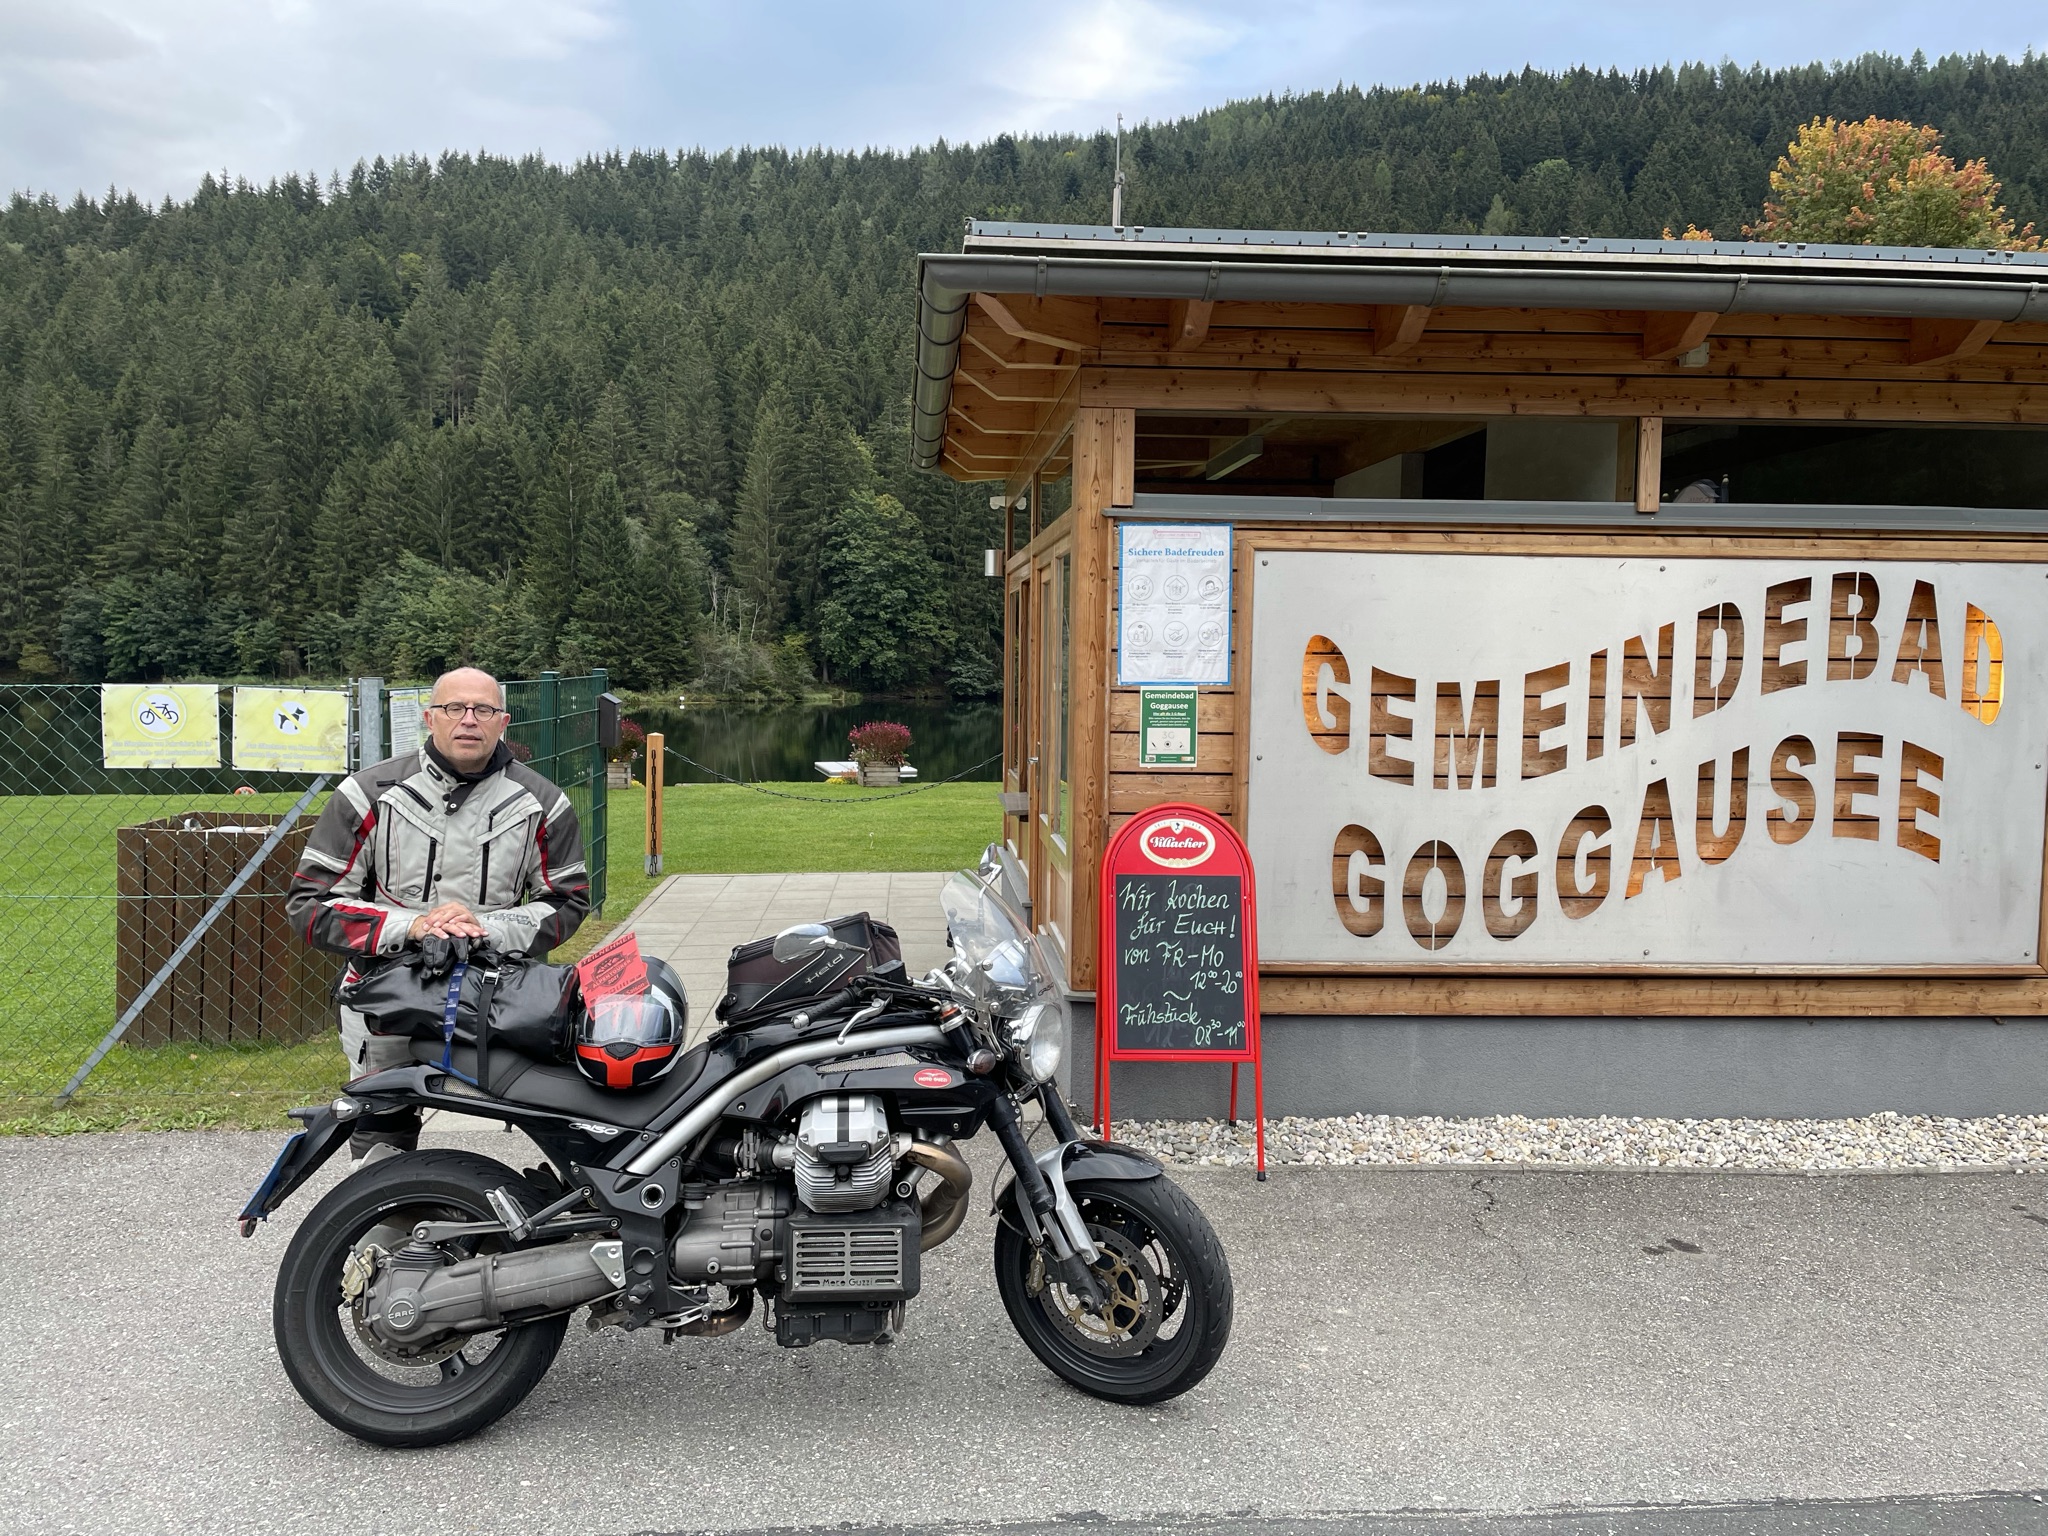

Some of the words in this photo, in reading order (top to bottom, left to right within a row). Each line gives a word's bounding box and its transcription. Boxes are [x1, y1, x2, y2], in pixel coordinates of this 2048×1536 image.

[1128, 547, 1163, 556] Sichere
[1165, 547, 1225, 557] Badefreuden
[1301, 571, 2004, 790] GEMEINDEBAD
[1150, 702, 1189, 710] Goggausee
[1149, 836, 1206, 849] Villacher
[1332, 731, 1945, 951] GOGGAUSEE
[1119, 881, 1156, 911] Wir
[1129, 910, 1166, 940] für
[583, 932, 634, 965] TEILNEHMER
[1124, 947, 1151, 965] von
[592, 959, 631, 988] ALPENTOURER
[1120, 1001, 1202, 1026] Frühstück
[849, 1278, 873, 1286] Guzzi
